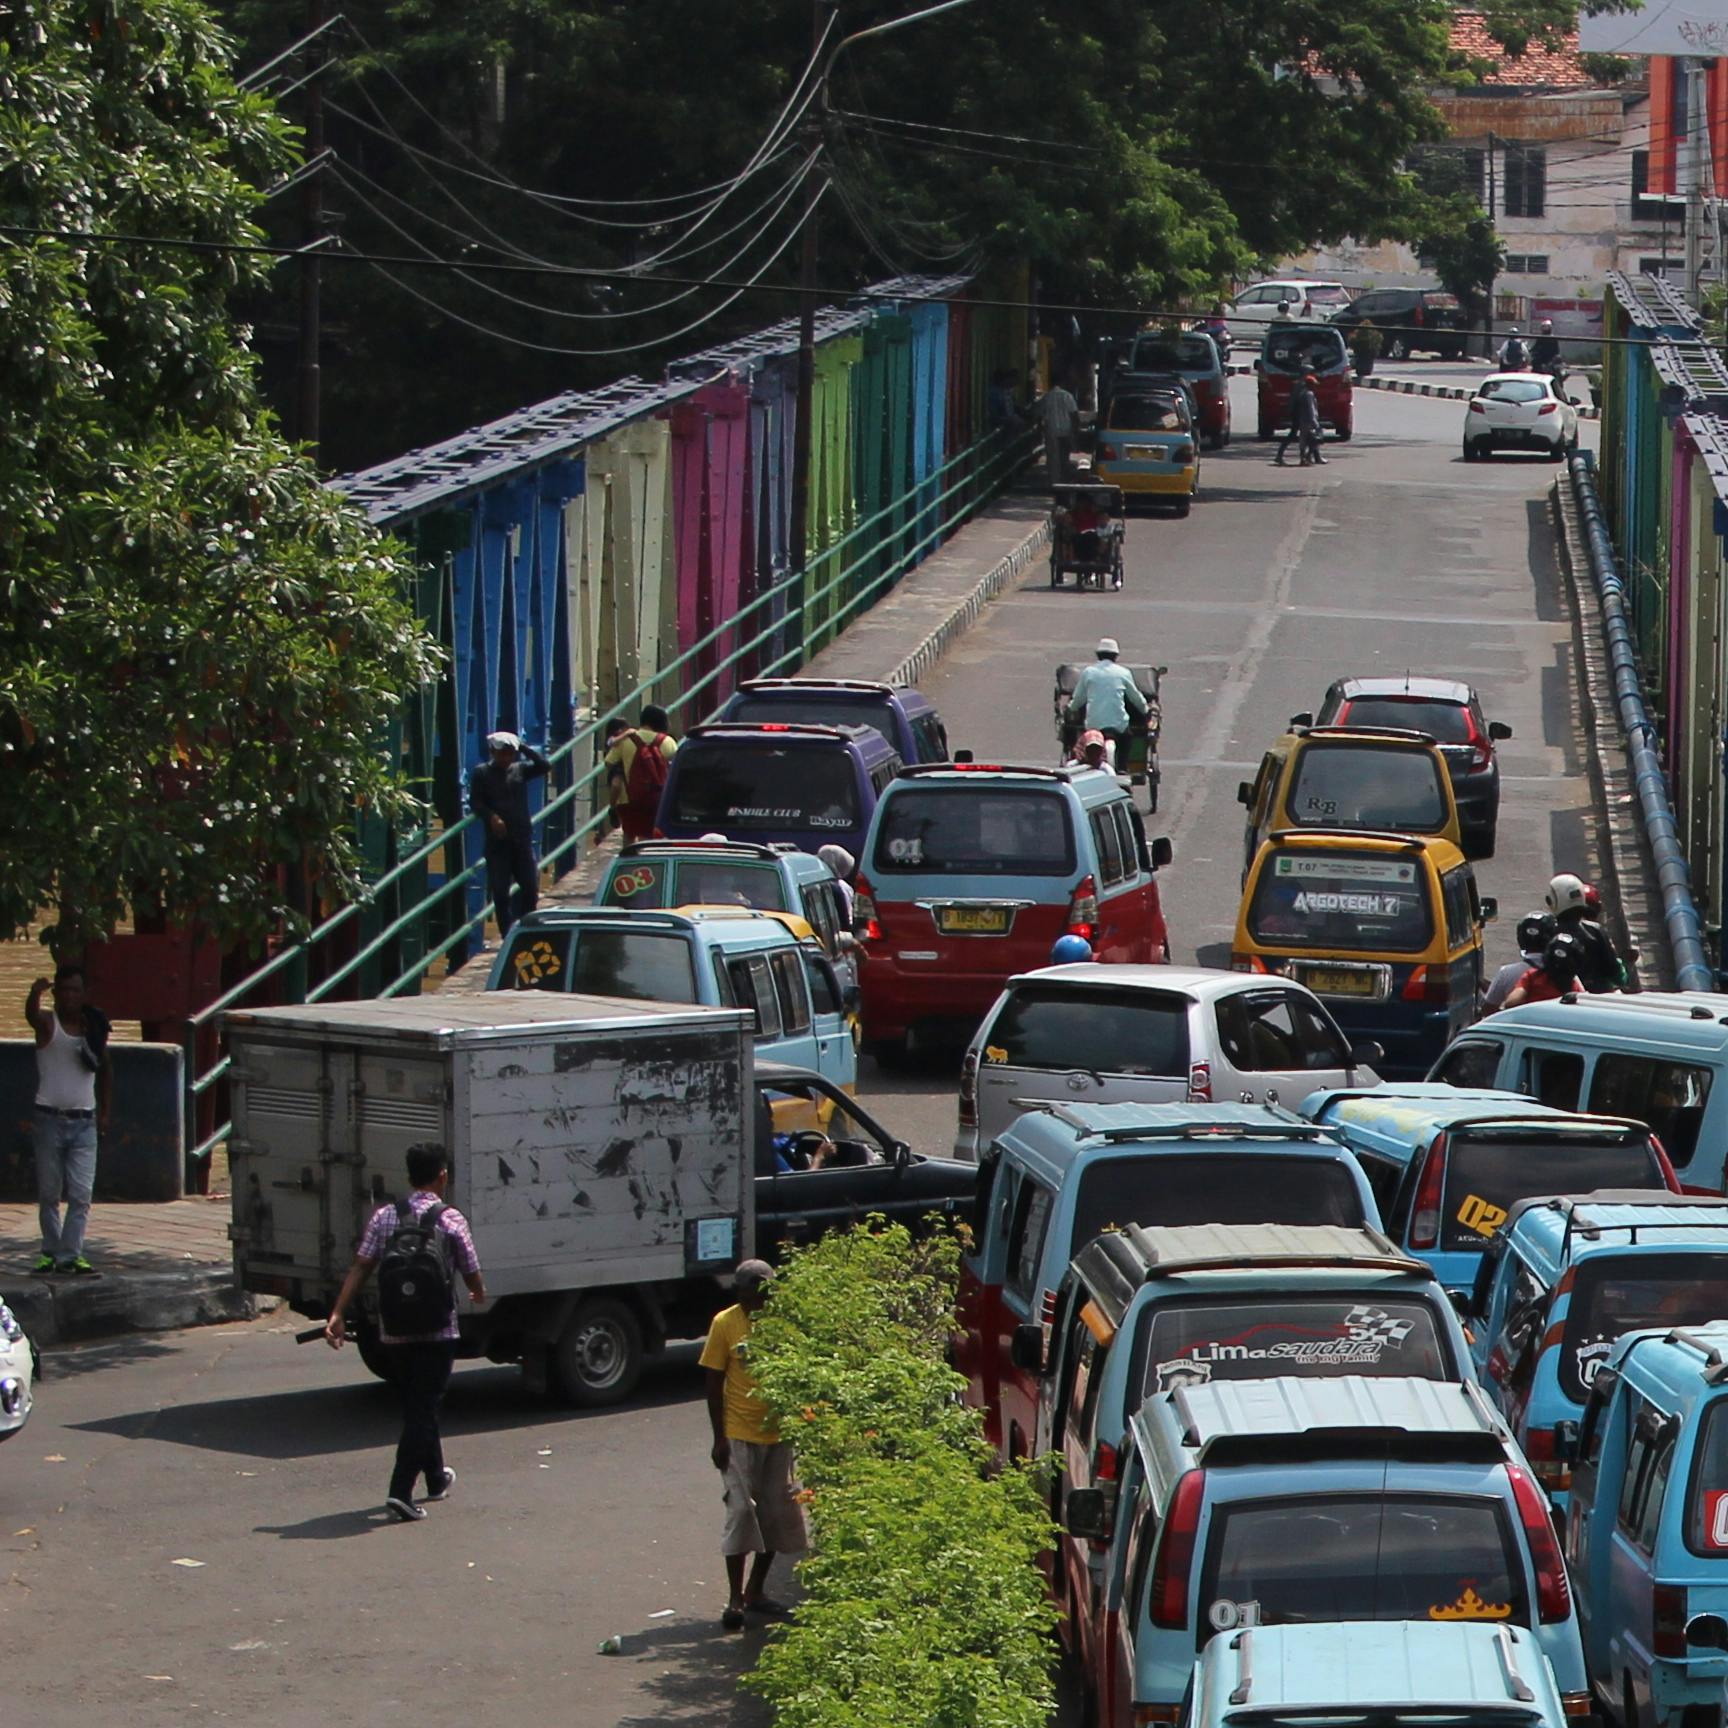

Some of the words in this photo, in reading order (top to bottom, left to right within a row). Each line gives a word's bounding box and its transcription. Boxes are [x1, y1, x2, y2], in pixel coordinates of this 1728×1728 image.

[889, 838, 922, 859] 01
[614, 866, 655, 897] 03
[1292, 891, 1379, 914] ARGOTECH
[1456, 1194, 1508, 1239] 02
[1267, 1338, 1382, 1359] saudara
[1209, 1599, 1263, 1631] 01
